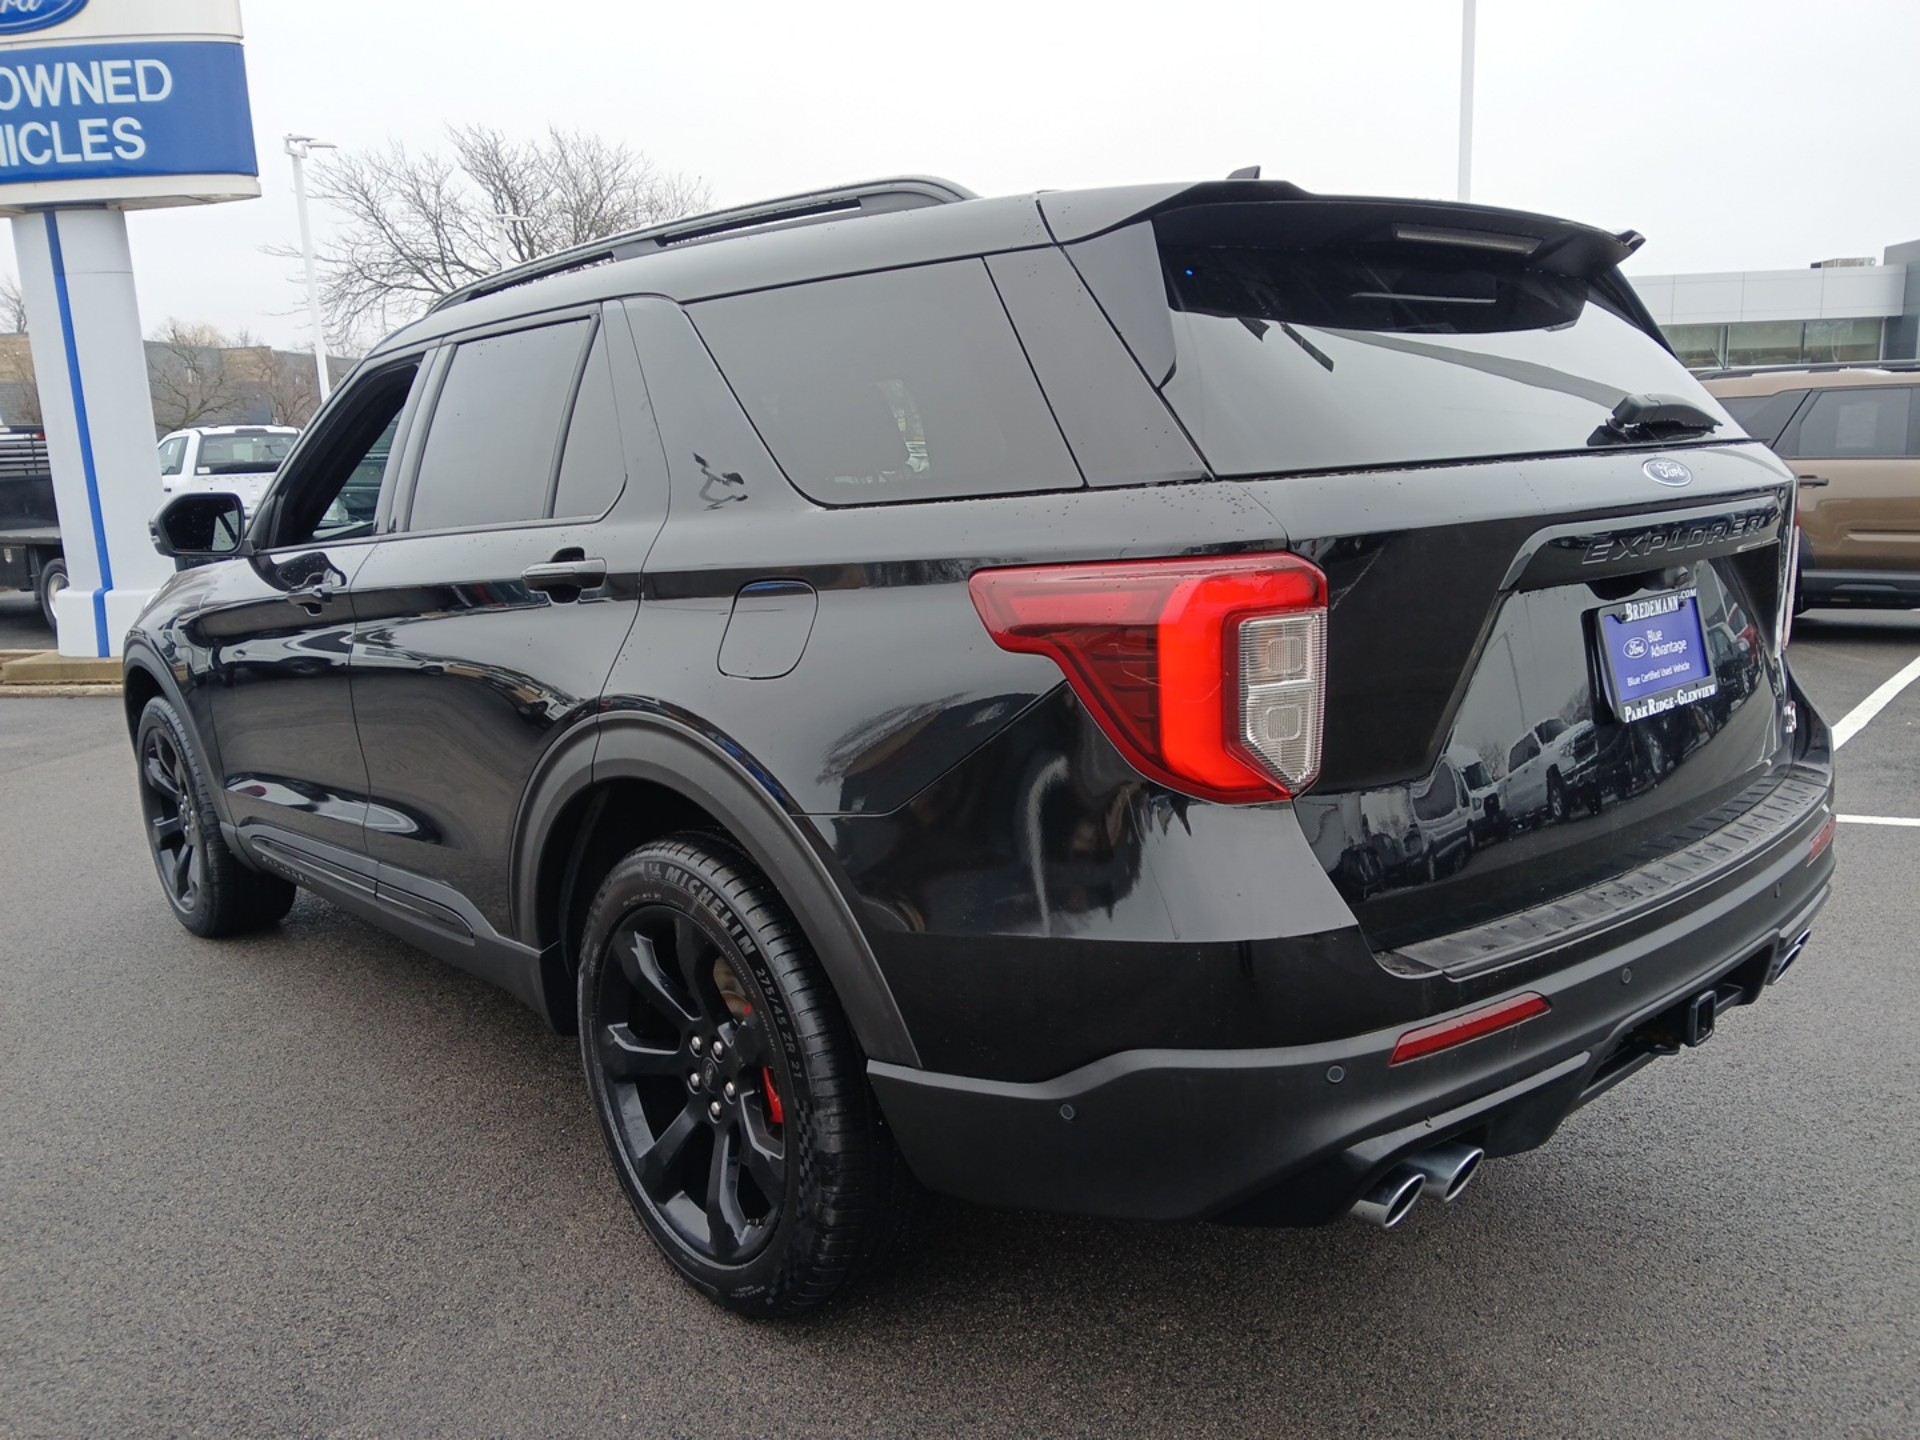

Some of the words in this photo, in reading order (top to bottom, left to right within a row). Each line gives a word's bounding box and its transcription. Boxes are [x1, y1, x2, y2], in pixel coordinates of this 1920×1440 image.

[0, 59, 173, 110] OWNED
[0, 117, 146, 167] ICLES
[1581, 515, 1762, 565] EXPLORER
[1646, 630, 1663, 643] Blue
[1650, 639, 1687, 658] Advantage
[1627, 676, 1640, 687] Blue
[1661, 666, 1673, 677] Used
[1673, 661, 1691, 673] Vehicle
[664, 866, 757, 955] MICHELIN
[755, 968, 788, 1025] 275/45
[782, 1031, 796, 1053] ZR
